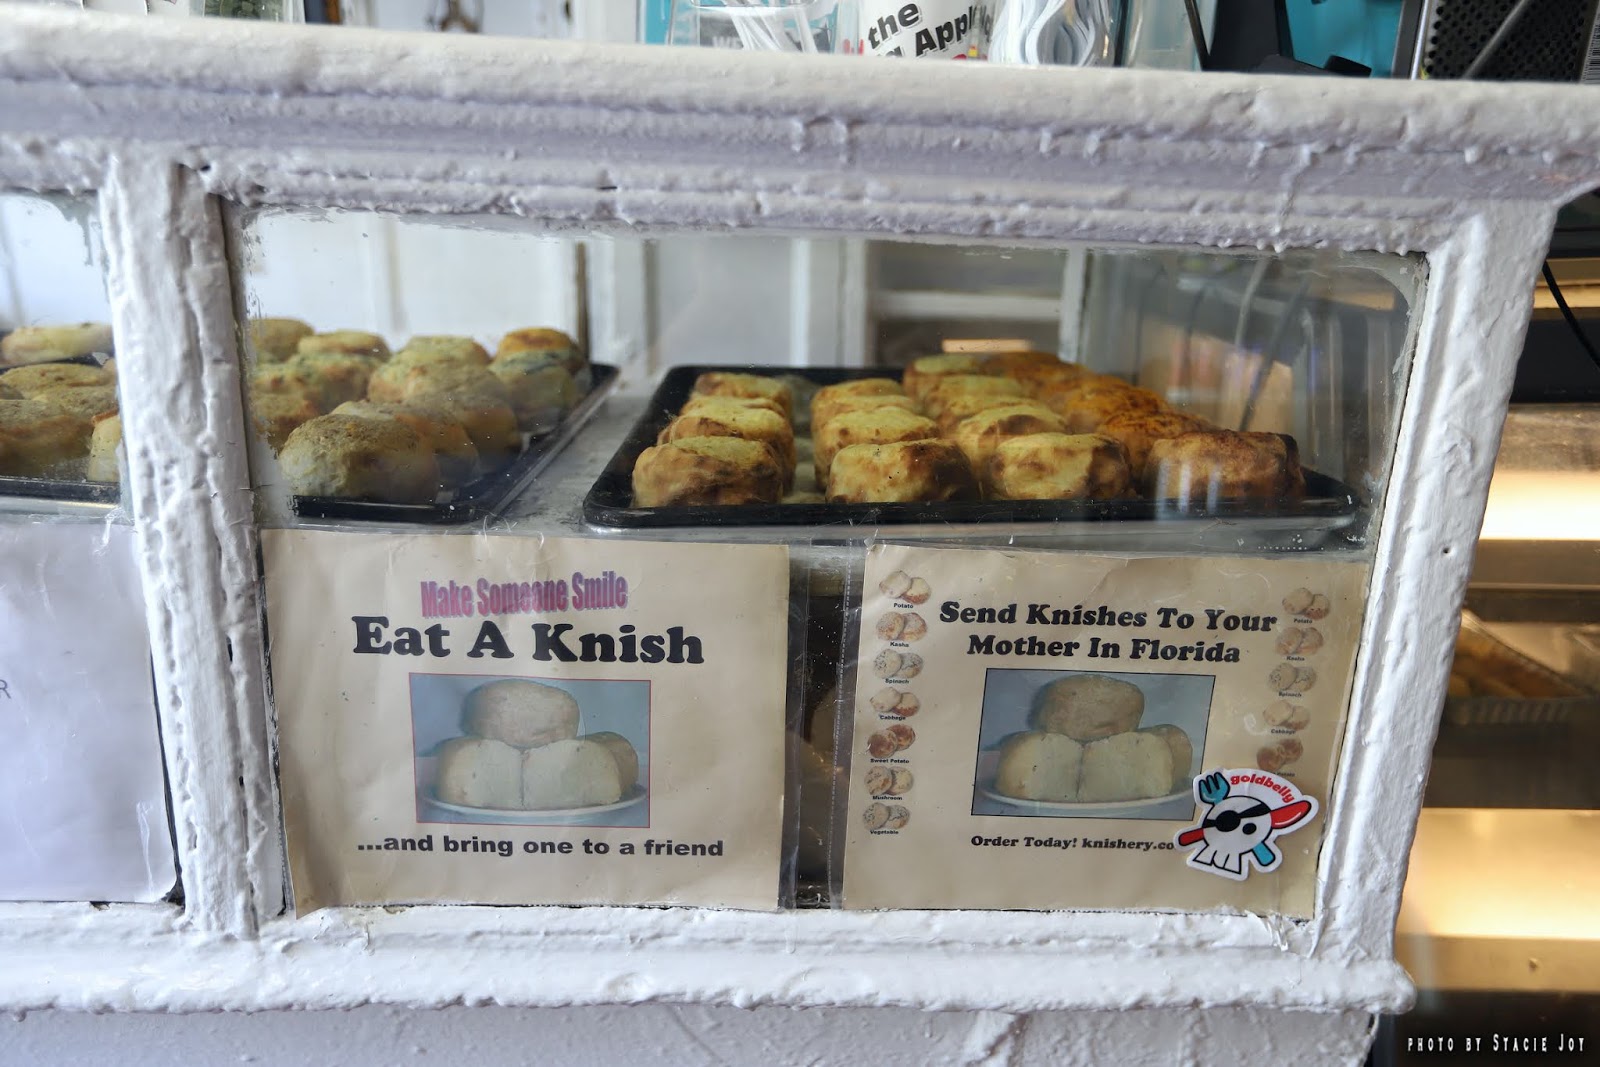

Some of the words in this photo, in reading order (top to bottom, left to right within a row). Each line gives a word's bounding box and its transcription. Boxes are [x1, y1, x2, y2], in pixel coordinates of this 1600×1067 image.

[868, 3, 921, 49] the
[915, 5, 976, 57] Appl
[420, 580, 474, 618] Make
[476, 573, 570, 618] Someone
[571, 570, 629, 611] Smile
[939, 600, 1018, 625] Send
[1025, 603, 1147, 628] Knishes
[1157, 607, 1195, 630] To
[1204, 608, 1278, 632] Your
[351, 616, 451, 658] Eat
[466, 620, 515, 659] A
[532, 622, 705, 664] Knish
[966, 634, 1080, 657] Mother
[1087, 637, 1121, 660] In
[1129, 638, 1241, 663] Florida
[1230, 774, 1295, 803] goldbelly
[357, 834, 434, 852] ...and
[443, 836, 514, 857] bring
[523, 839, 574, 854] one
[582, 838, 611, 856] to
[619, 841, 636, 856] a
[644, 838, 724, 857] friend
[970, 835, 1019, 848] Order
[1024, 836, 1078, 850] Today!
[1081, 838, 1175, 852] knishery.co
